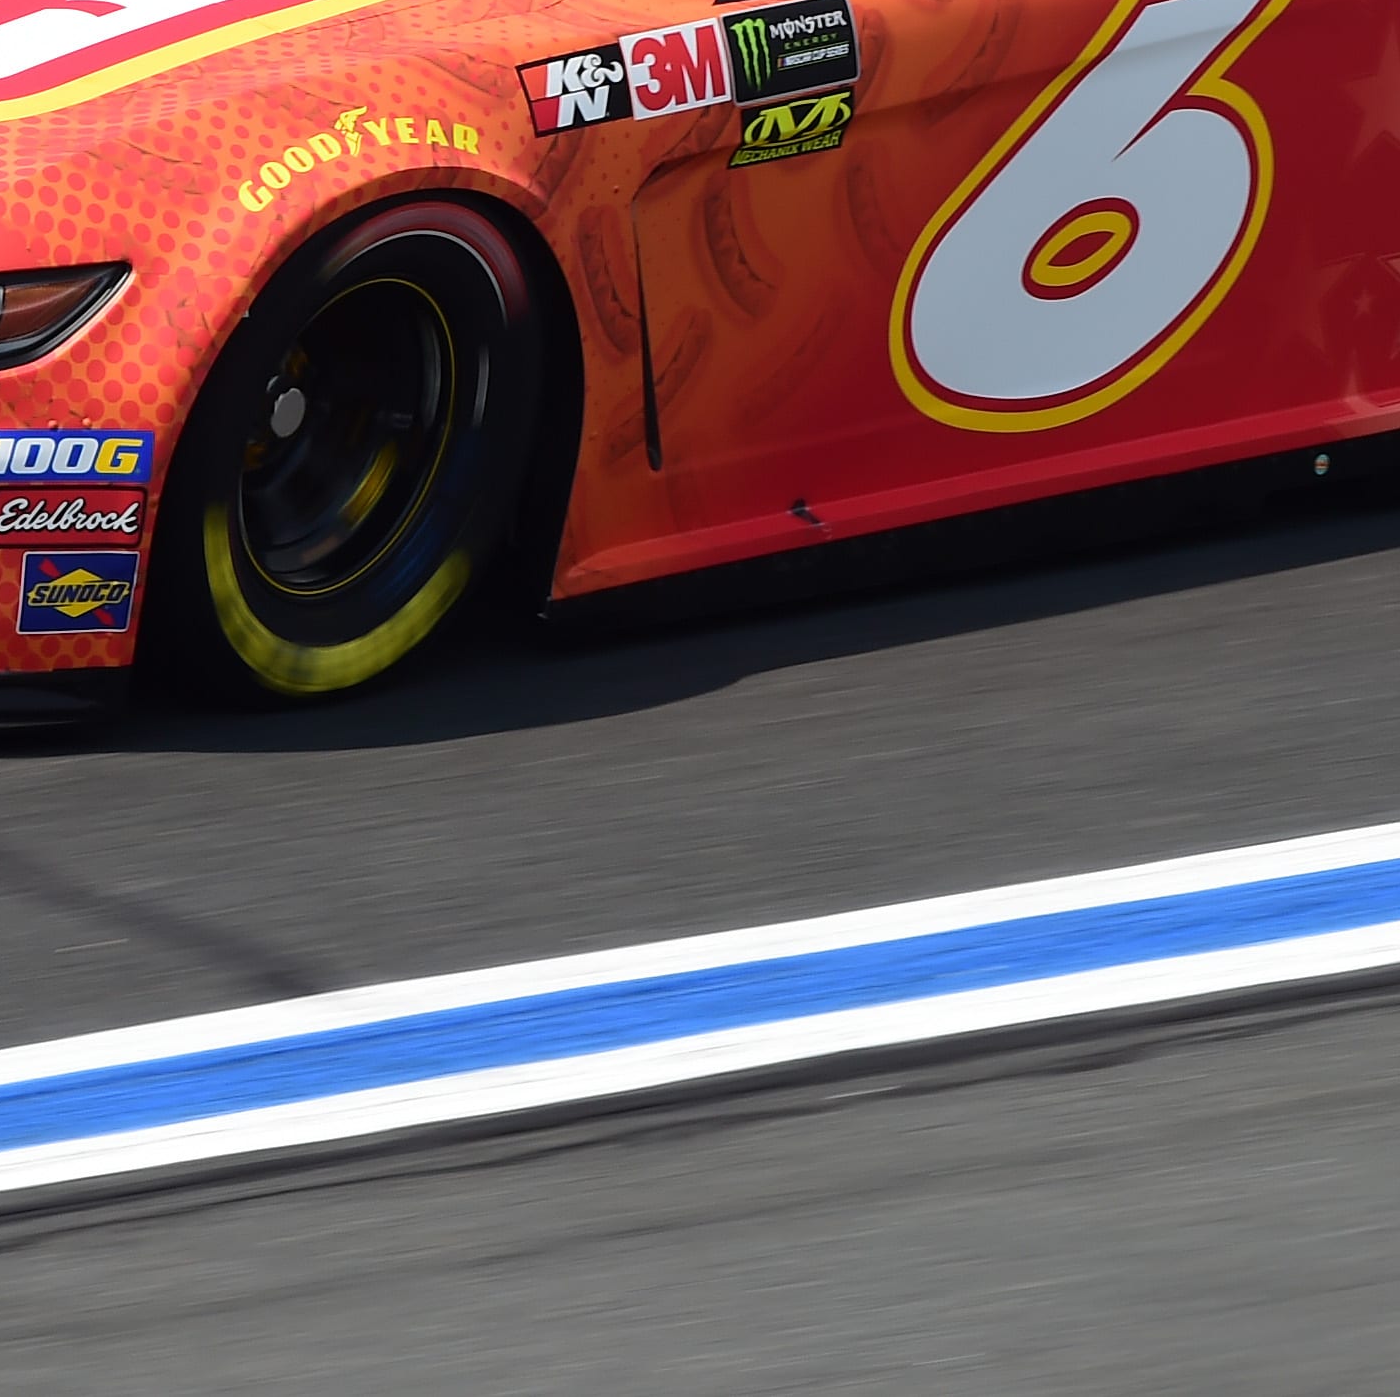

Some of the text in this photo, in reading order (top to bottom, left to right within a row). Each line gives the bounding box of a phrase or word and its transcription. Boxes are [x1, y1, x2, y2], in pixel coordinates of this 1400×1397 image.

[769, 10, 848, 40] MONSTER
[784, 32, 839, 50] ENERGY
[631, 24, 727, 112] 3M
[731, 129, 842, 166] MECHANIX WEAR
[27, 580, 131, 606] SUNOCO
